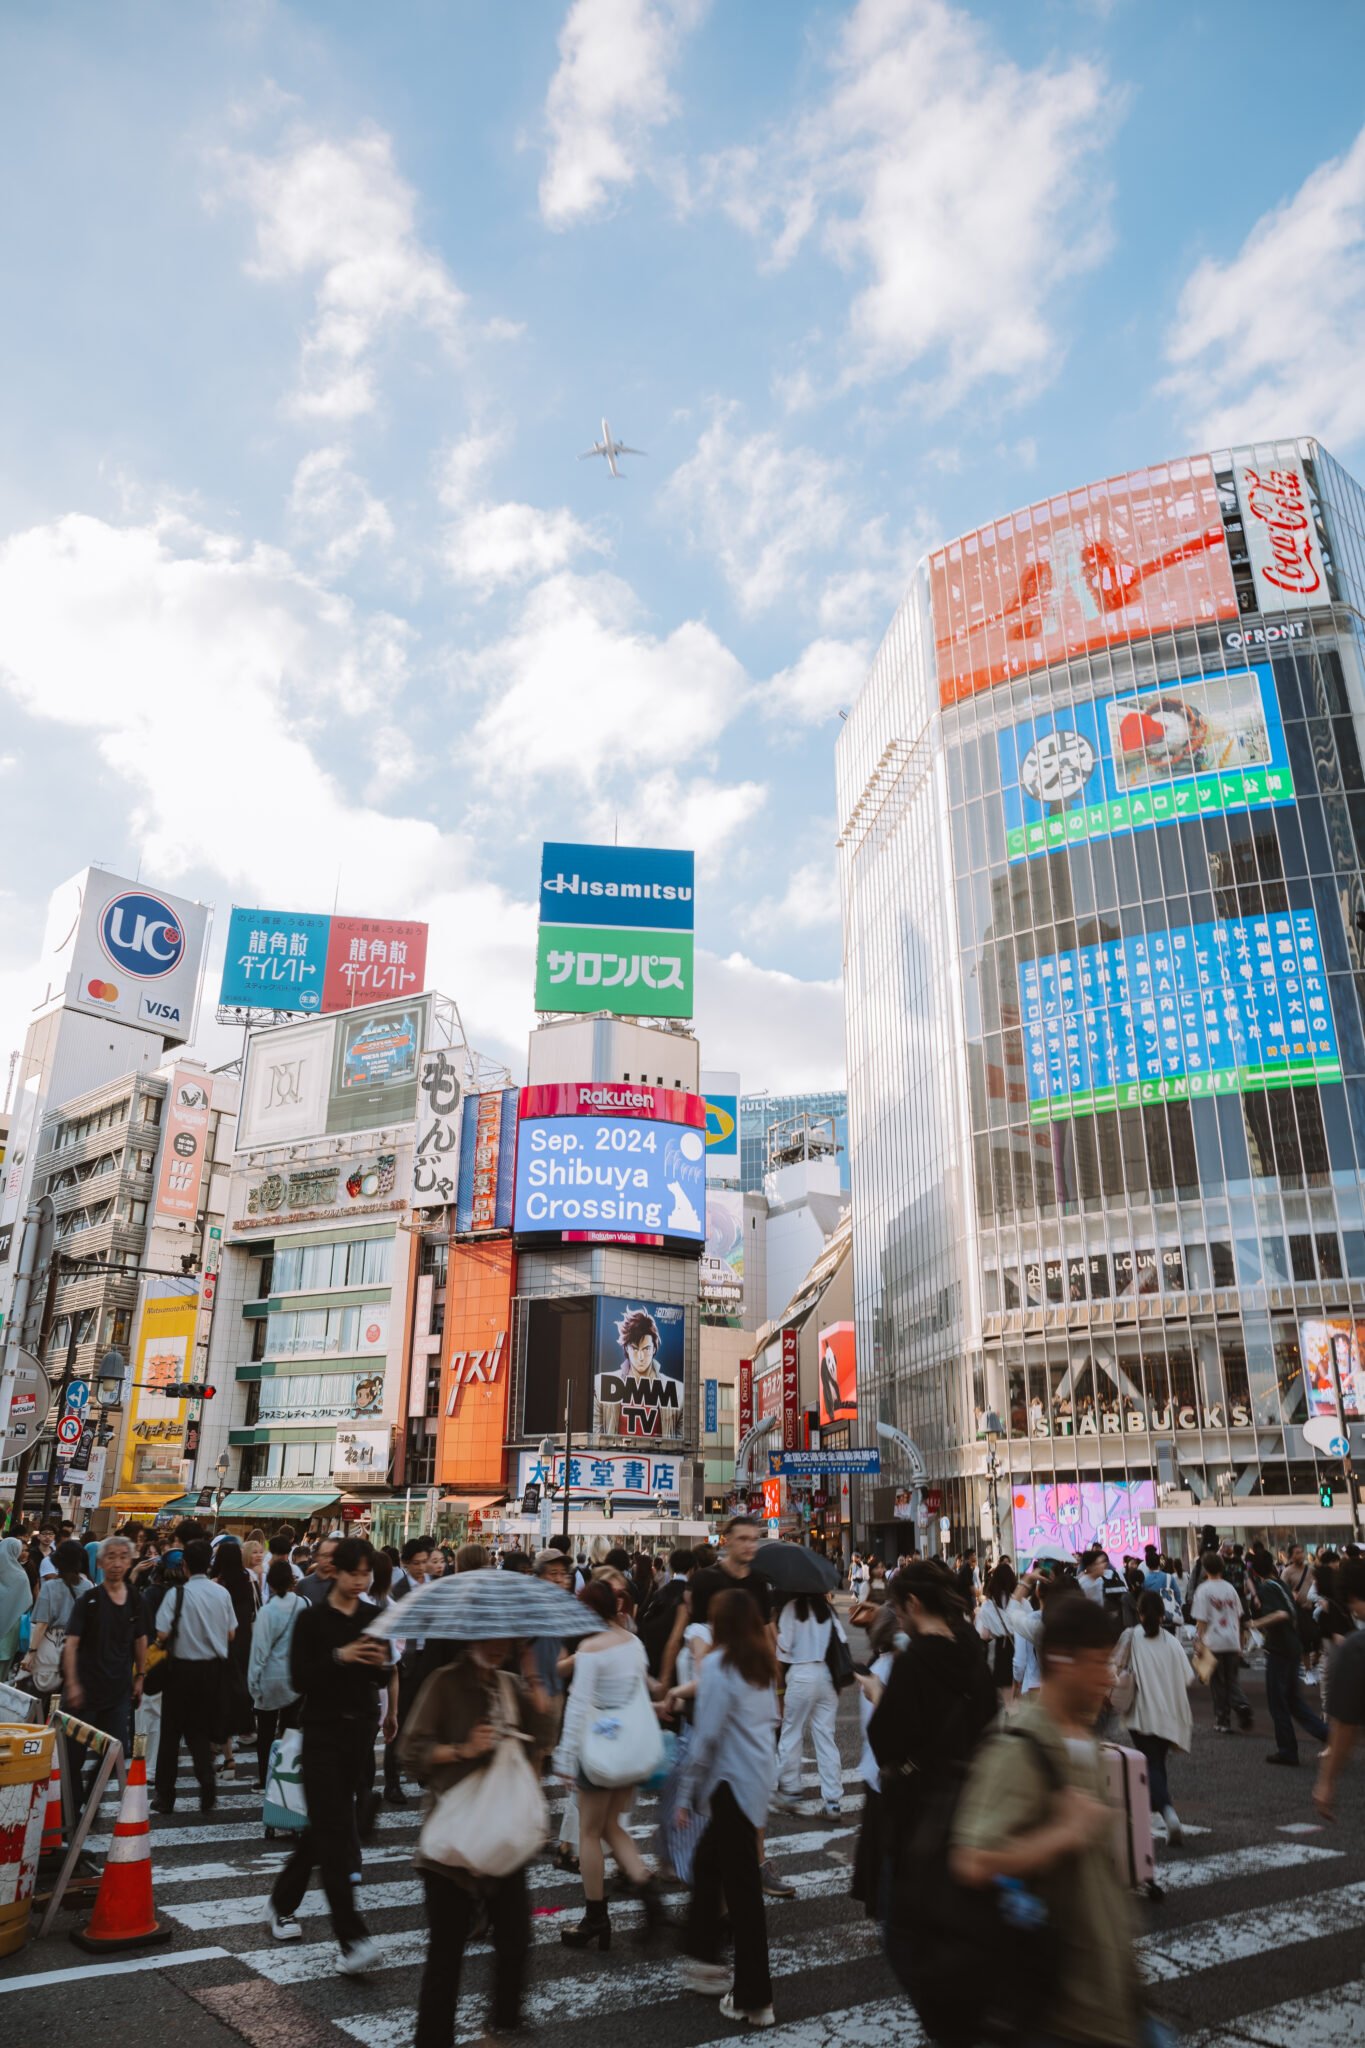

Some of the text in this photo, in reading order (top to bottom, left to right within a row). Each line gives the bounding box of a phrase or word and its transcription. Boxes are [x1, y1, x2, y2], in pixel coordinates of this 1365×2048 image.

[1243, 467, 1320, 594] Coca-Cola
[1226, 622, 1304, 650] QFRONT
[543, 873, 692, 901] Hisamitsu
[249, 930, 308, 957] 龍角散
[349, 937, 408, 964] 龍角散
[238, 955, 316, 982] ダイレクト
[339, 963, 416, 990] ダイレクト
[546, 950, 684, 990] サロンパス
[144, 999, 180, 1022] VISA
[579, 1088, 654, 1109] Rakuten
[1128, 1072, 1238, 1102] ECONOMY
[414, 1052, 460, 1200] もんじゃ
[530, 1127, 657, 1154] Sep. 2024
[528, 1158, 648, 1190] Shibuya
[526, 1192, 661, 1228] Crossing
[1115, 1252, 1181, 1272] LOUNGE
[784, 1338, 796, 1401] カラオケ
[600, 1373, 679, 1408] DMM
[622, 1407, 658, 1435] TV
[1036, 1405, 1251, 1437] STARBUCKS
[529, 1461, 674, 1490] 大盛堂書店
